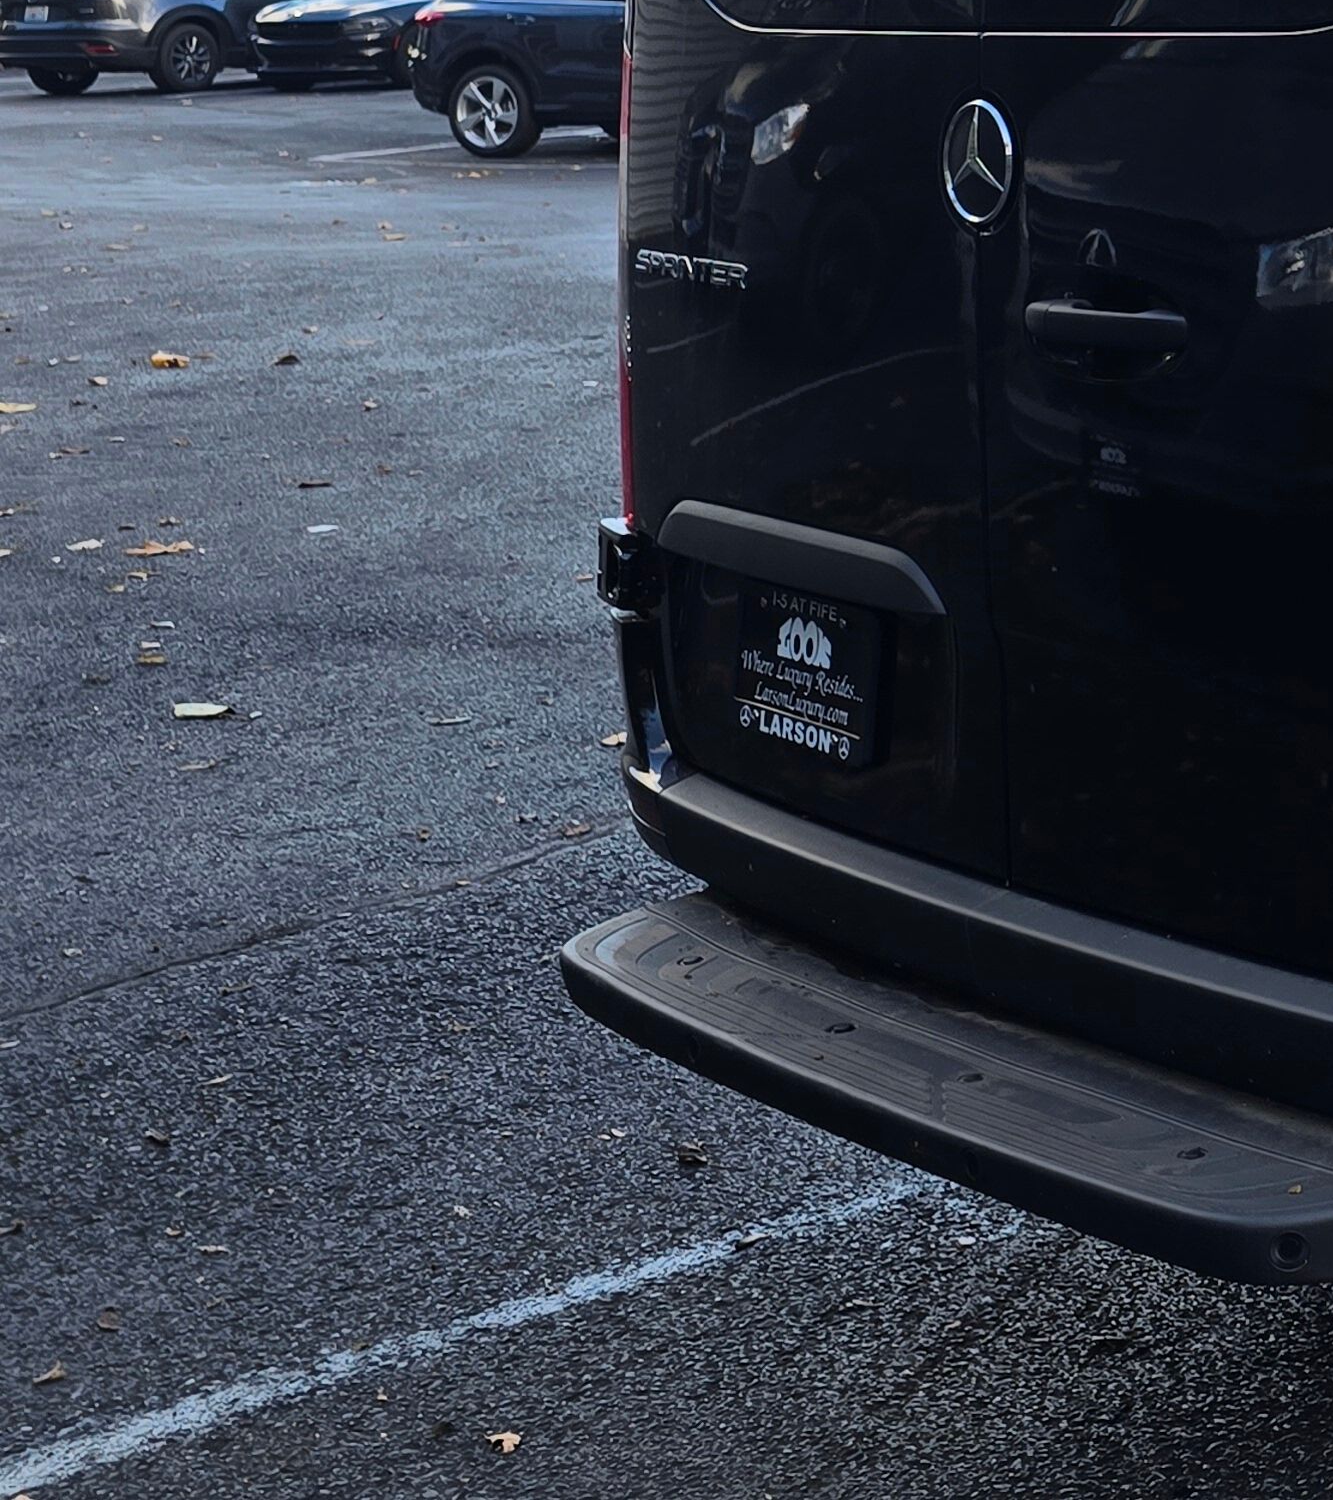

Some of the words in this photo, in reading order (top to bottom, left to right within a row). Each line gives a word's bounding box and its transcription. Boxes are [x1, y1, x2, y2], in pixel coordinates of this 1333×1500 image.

[789, 596, 807, 613] AT
[808, 601, 837, 622] FIFE
[741, 649, 775, 677] Where
[775, 660, 814, 696] Luxury
[754, 680, 849, 727] LarsonLuxury.com
[759, 709, 832, 754] LARSON
